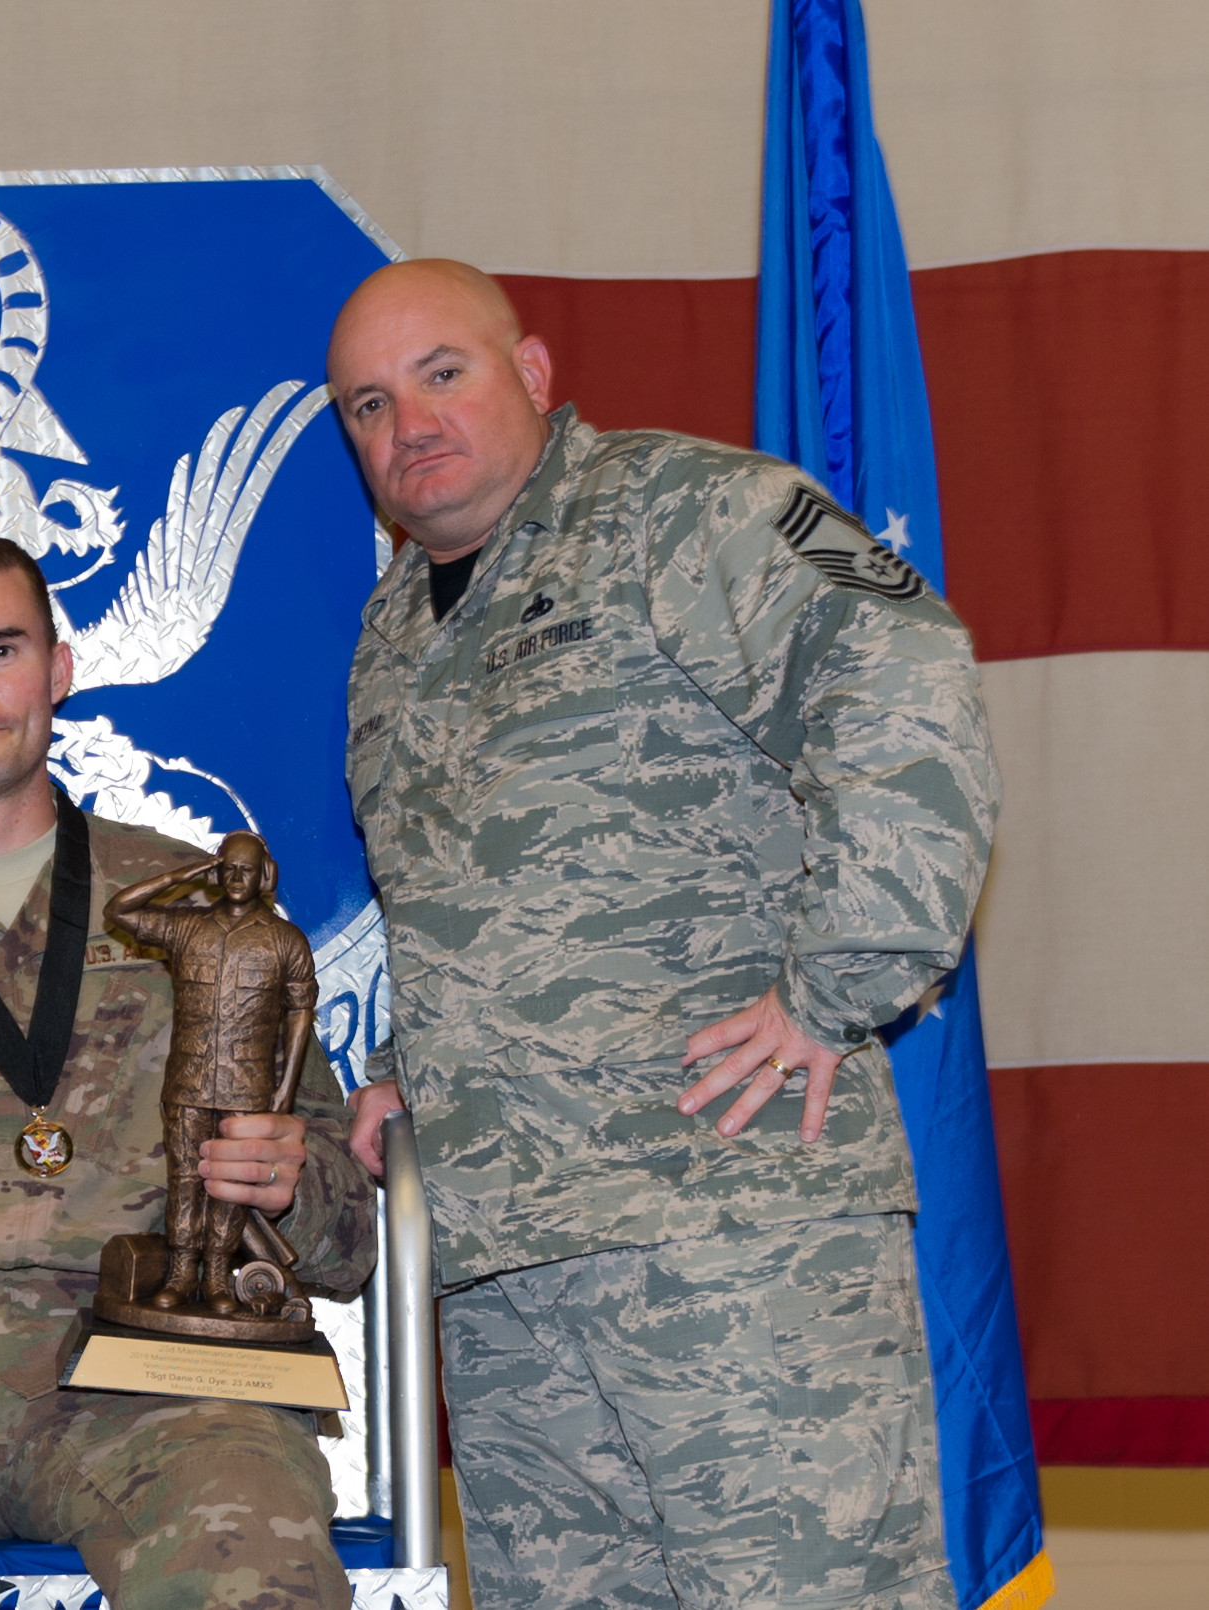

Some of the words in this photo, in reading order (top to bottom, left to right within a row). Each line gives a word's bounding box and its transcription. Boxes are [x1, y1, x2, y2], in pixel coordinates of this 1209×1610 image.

[486, 651, 510, 675] U.S.
[514, 636, 538, 661] AIR
[541, 618, 592, 649] FORCE
[85, 944, 116, 965] U.S.
[145, 1370, 167, 1382] TSgt
[169, 1373, 193, 1382] Dane
[232, 1378, 242, 1387] 23
[245, 1379, 274, 1390] AMXS
